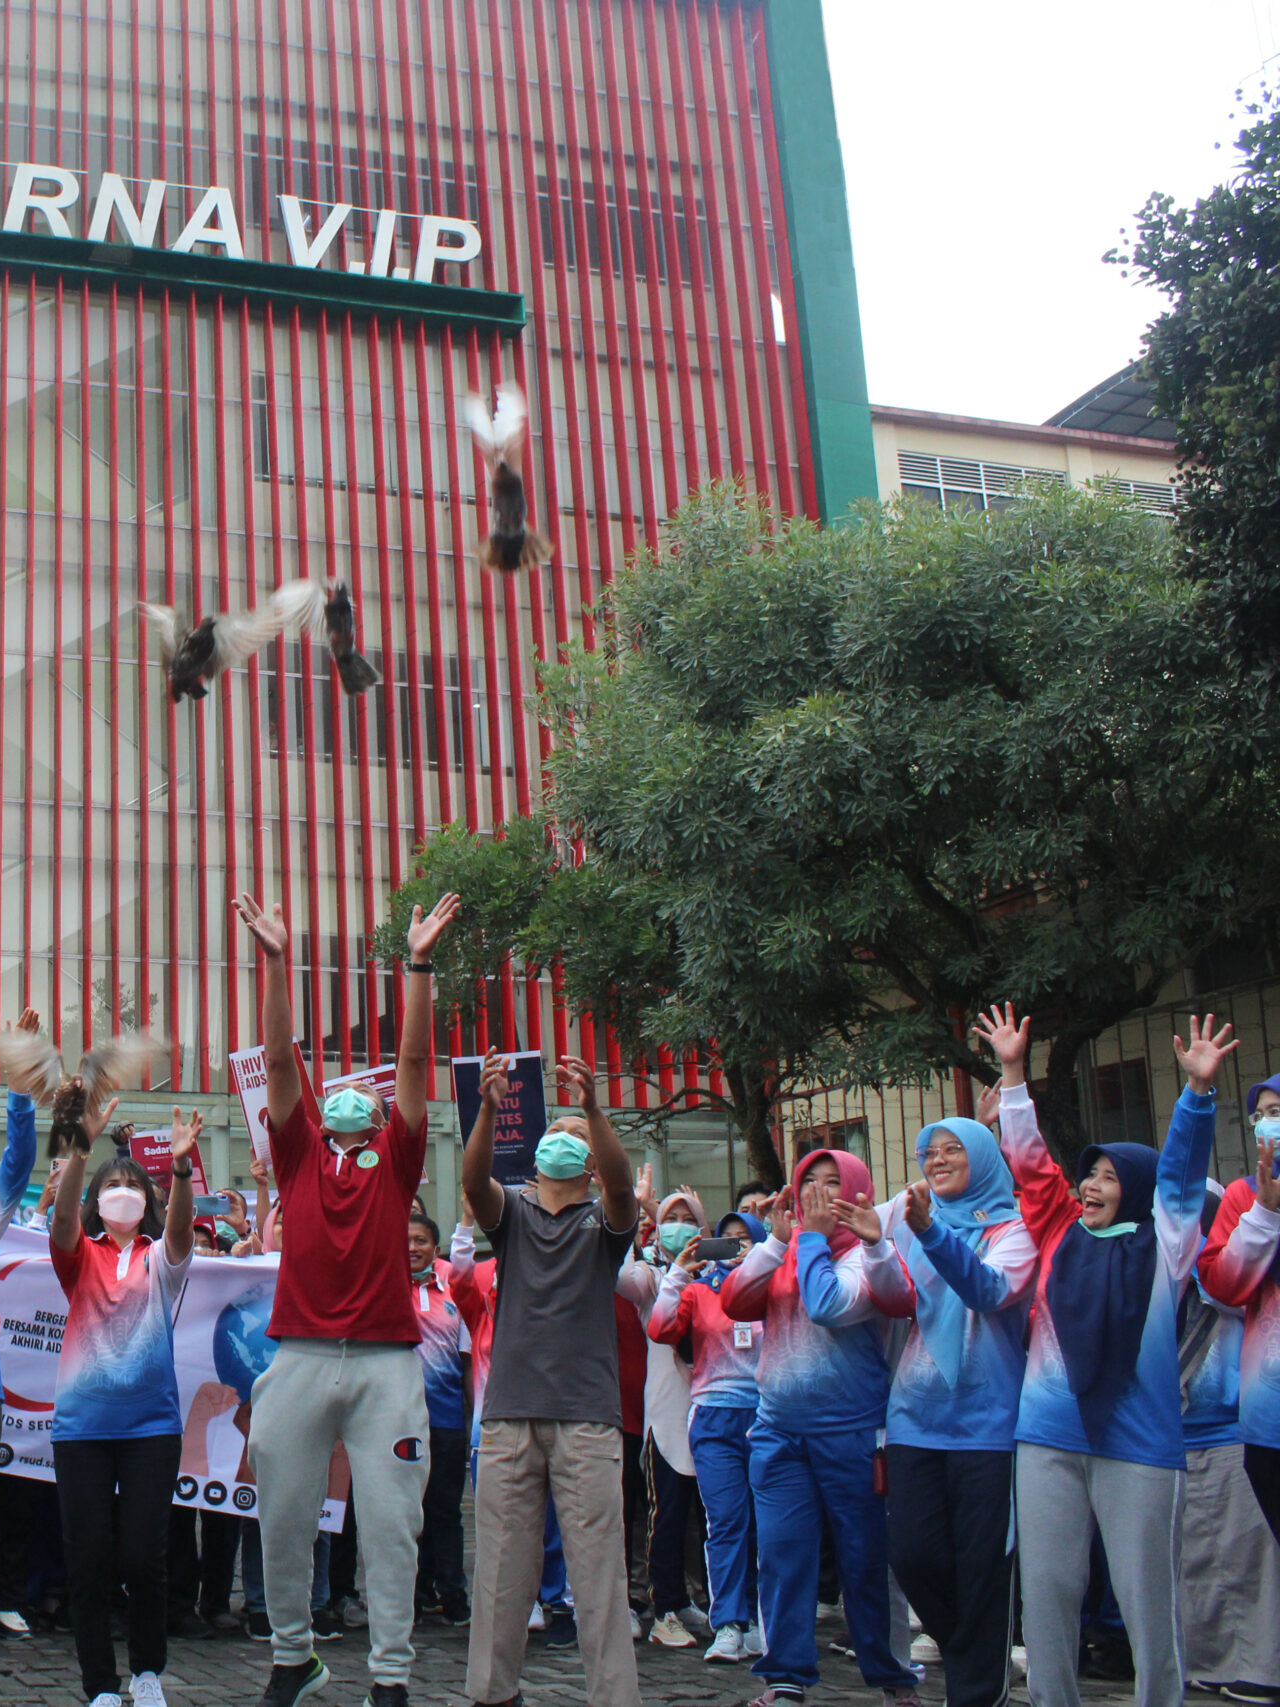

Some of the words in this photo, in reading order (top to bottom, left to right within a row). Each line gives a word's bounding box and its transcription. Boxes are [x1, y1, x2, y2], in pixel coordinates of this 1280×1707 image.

[279, 194, 482, 284] V.I.P
[241, 1056, 262, 1075] HIV
[246, 1073, 267, 1090] AIDS
[3, 1318, 46, 1337] BERSAMA
[10, 1334, 44, 1351] AKHIRI
